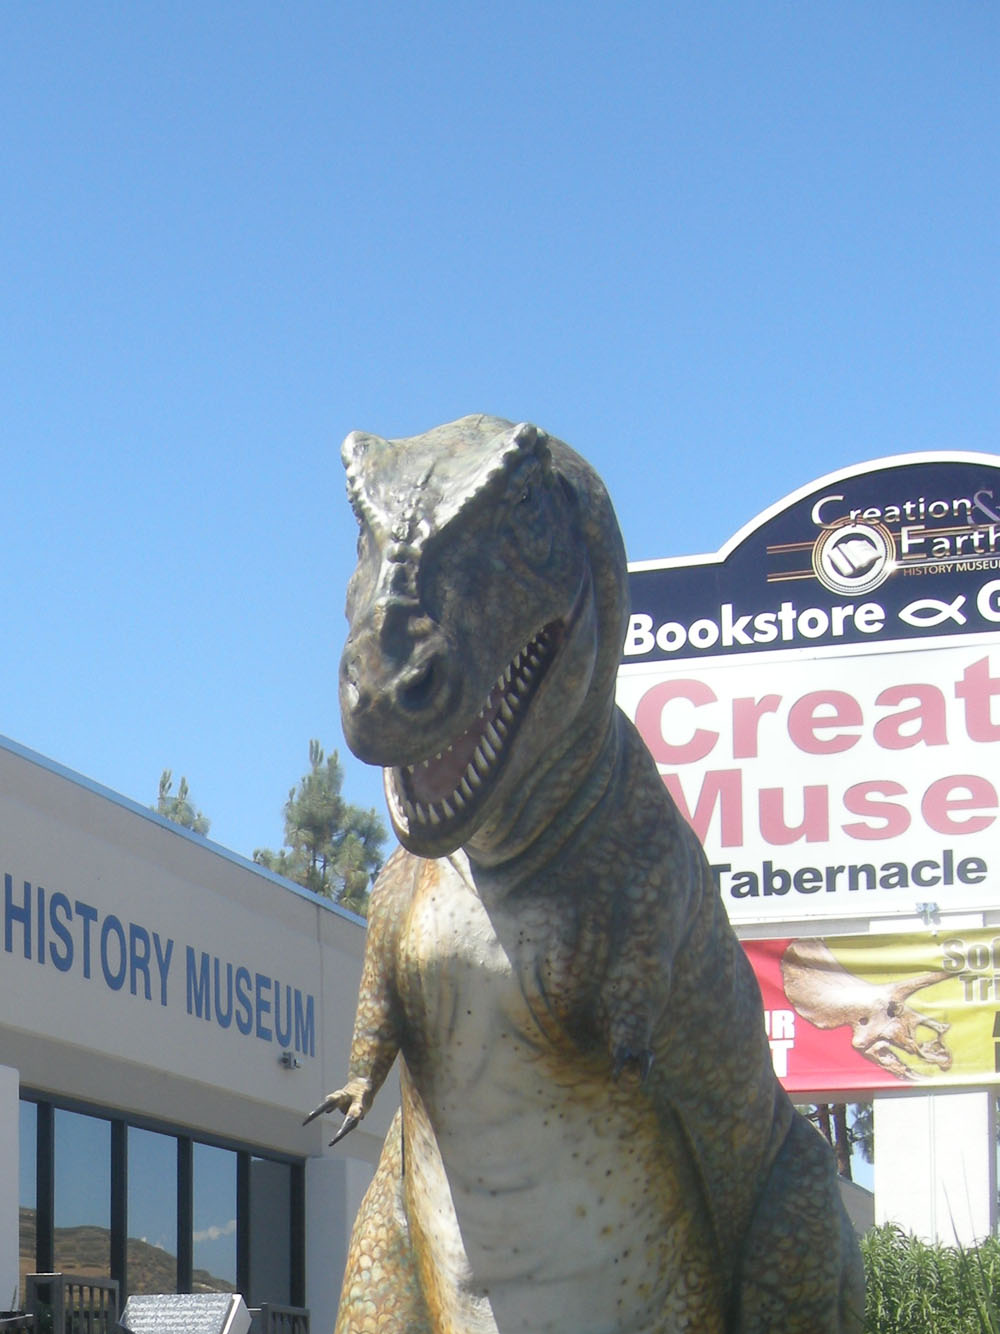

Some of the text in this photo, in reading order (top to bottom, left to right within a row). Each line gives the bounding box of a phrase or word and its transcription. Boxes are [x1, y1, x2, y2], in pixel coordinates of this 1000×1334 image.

[811, 494, 972, 529] Creation
[903, 563, 954, 577] HISTORY
[623, 602, 886, 656] Bookstore
[634, 655, 1000, 766] Creat
[711, 849, 988, 898] Tabernacle
[3, 872, 174, 1006] HISTORY
[185, 944, 316, 1058] MUSEUM
